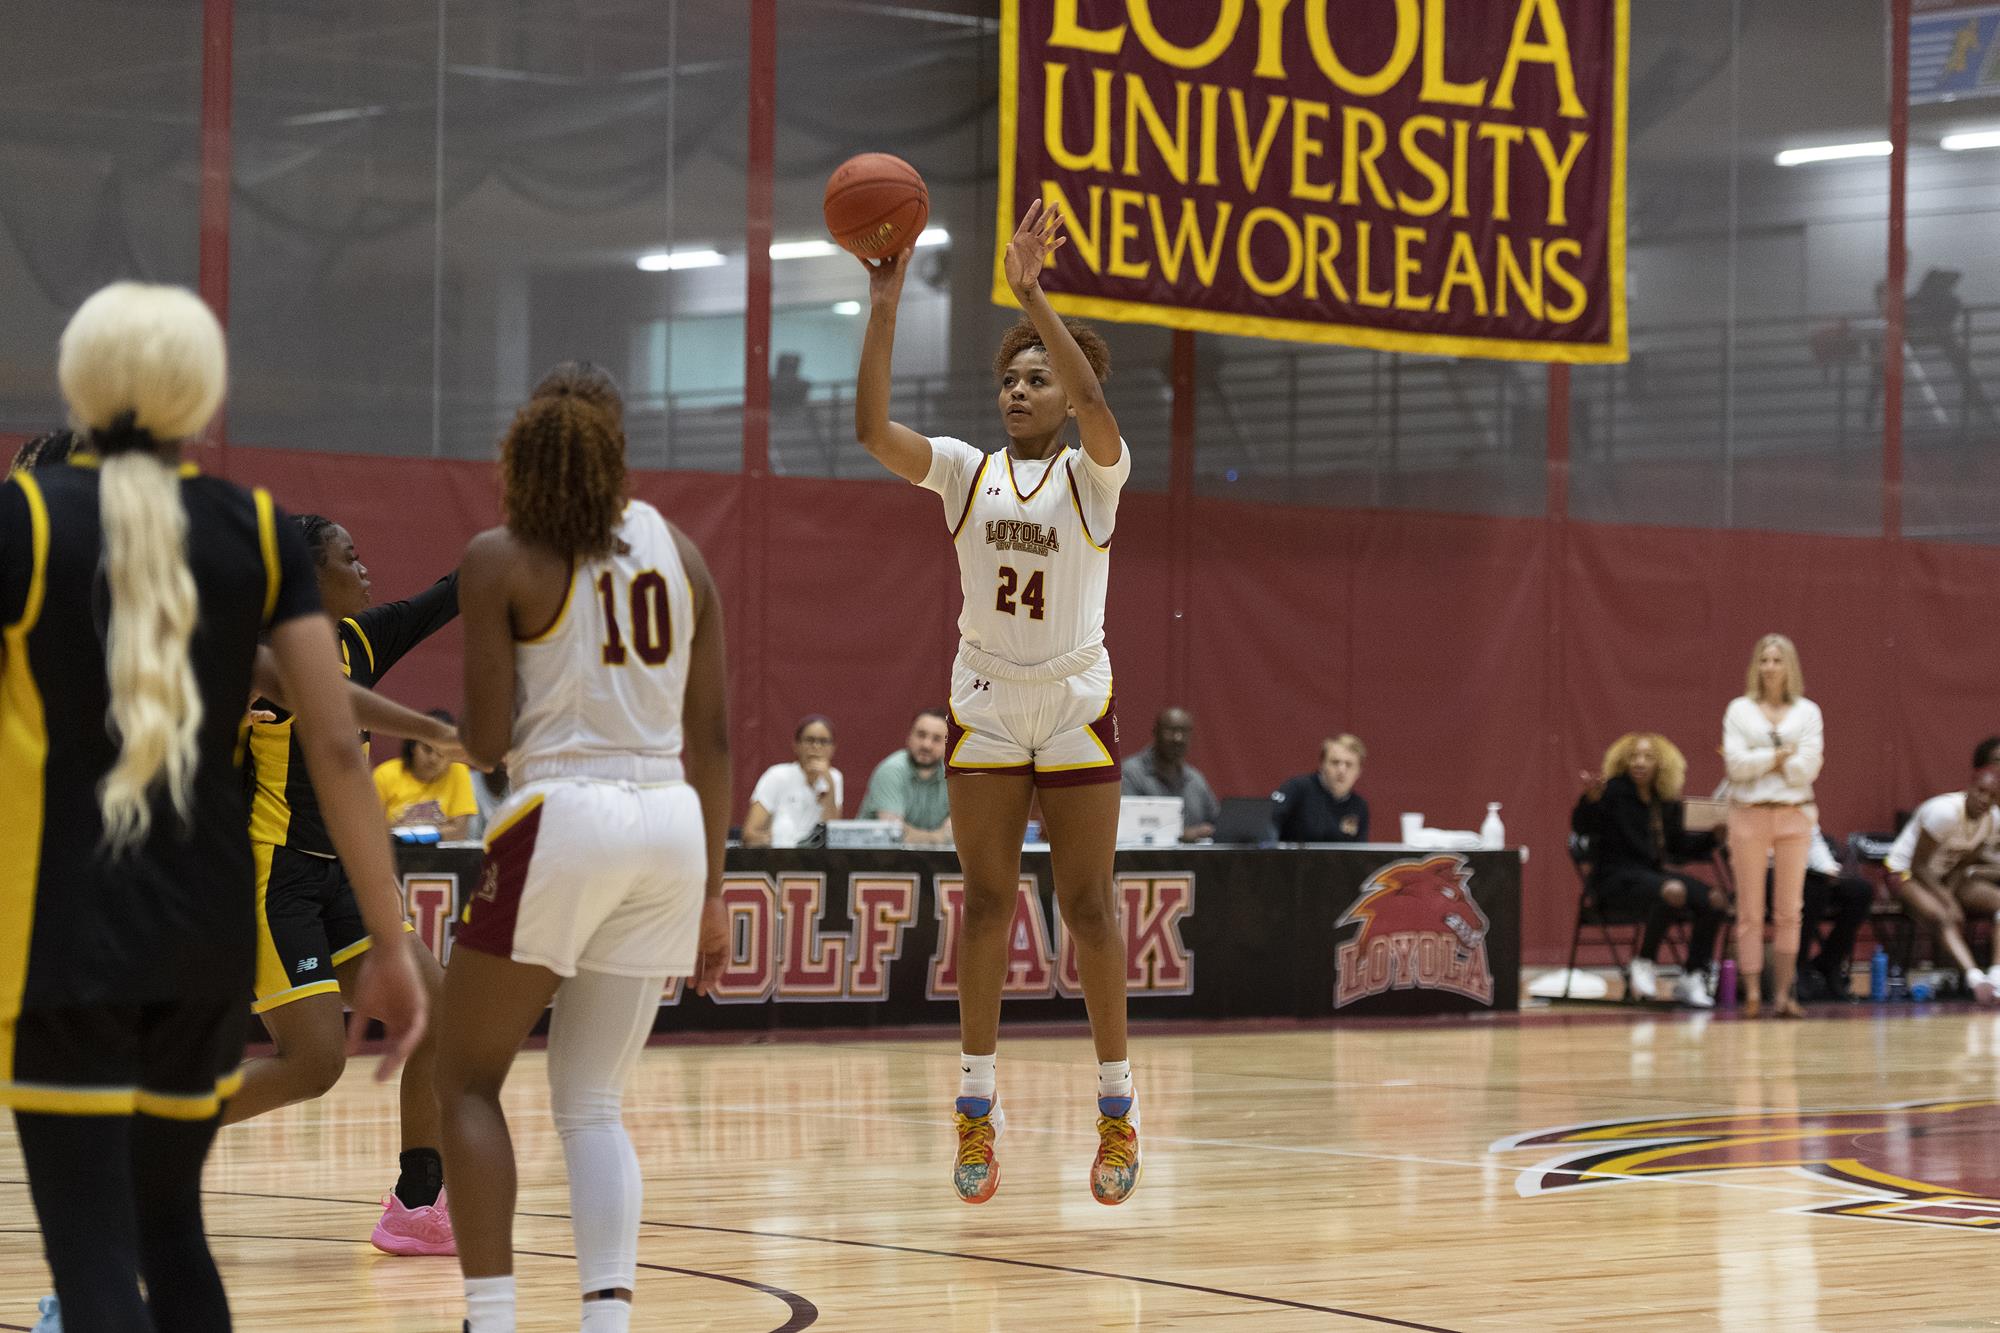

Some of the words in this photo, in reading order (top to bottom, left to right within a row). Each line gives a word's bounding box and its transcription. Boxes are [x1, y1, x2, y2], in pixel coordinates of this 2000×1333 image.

[1043, 61, 1589, 226] UNIVERSITY
[1040, 180, 1232, 287] NEW
[1236, 206, 1589, 324] ORLEANS
[985, 519, 1060, 553] LOYOLA
[597, 568, 673, 667] 10
[995, 565, 1045, 621] 24
[658, 870, 920, 1006] OLF
[925, 870, 1196, 1001] AK
[1333, 931, 1494, 1009] LOYOLA
